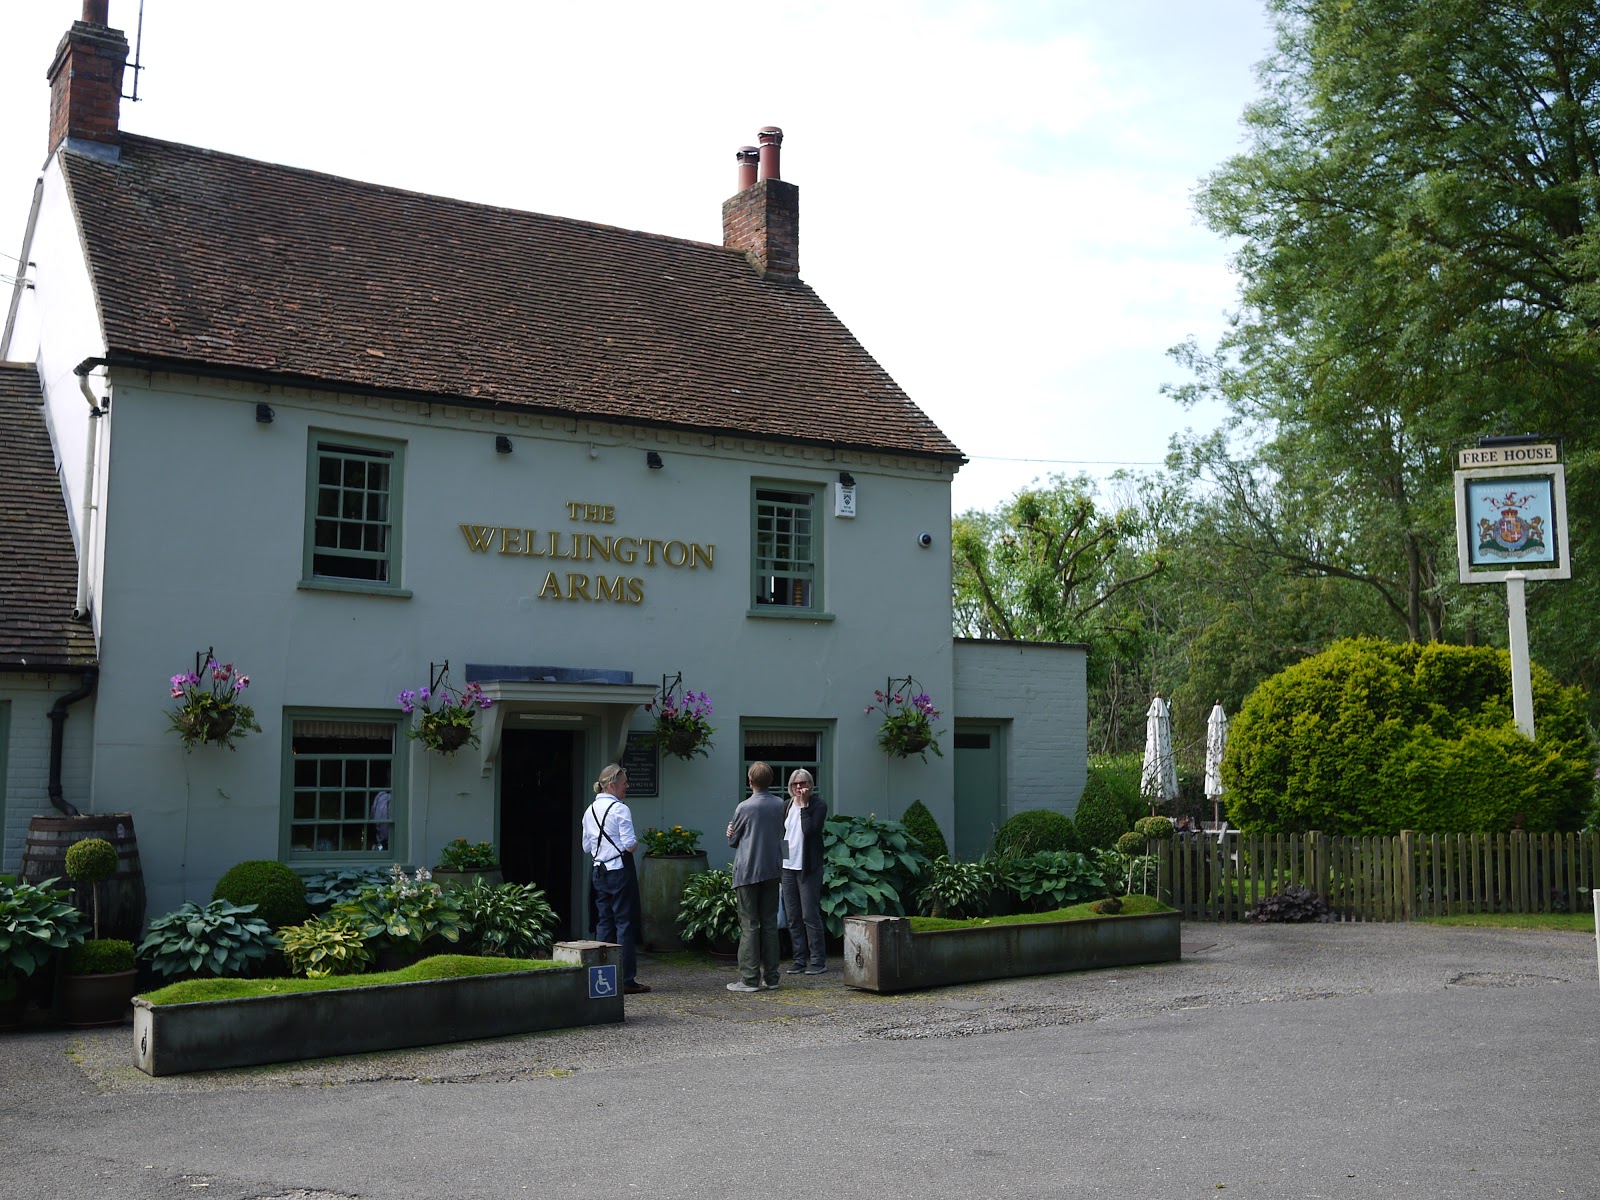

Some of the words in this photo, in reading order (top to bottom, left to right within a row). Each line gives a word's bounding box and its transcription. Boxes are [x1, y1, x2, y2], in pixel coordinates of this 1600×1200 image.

[1463, 451, 1498, 463] FREE
[1504, 447, 1553, 461] HOUSE
[566, 501, 616, 523] THE
[458, 523, 715, 569] WELLINGTON
[537, 571, 645, 603] ARMS
